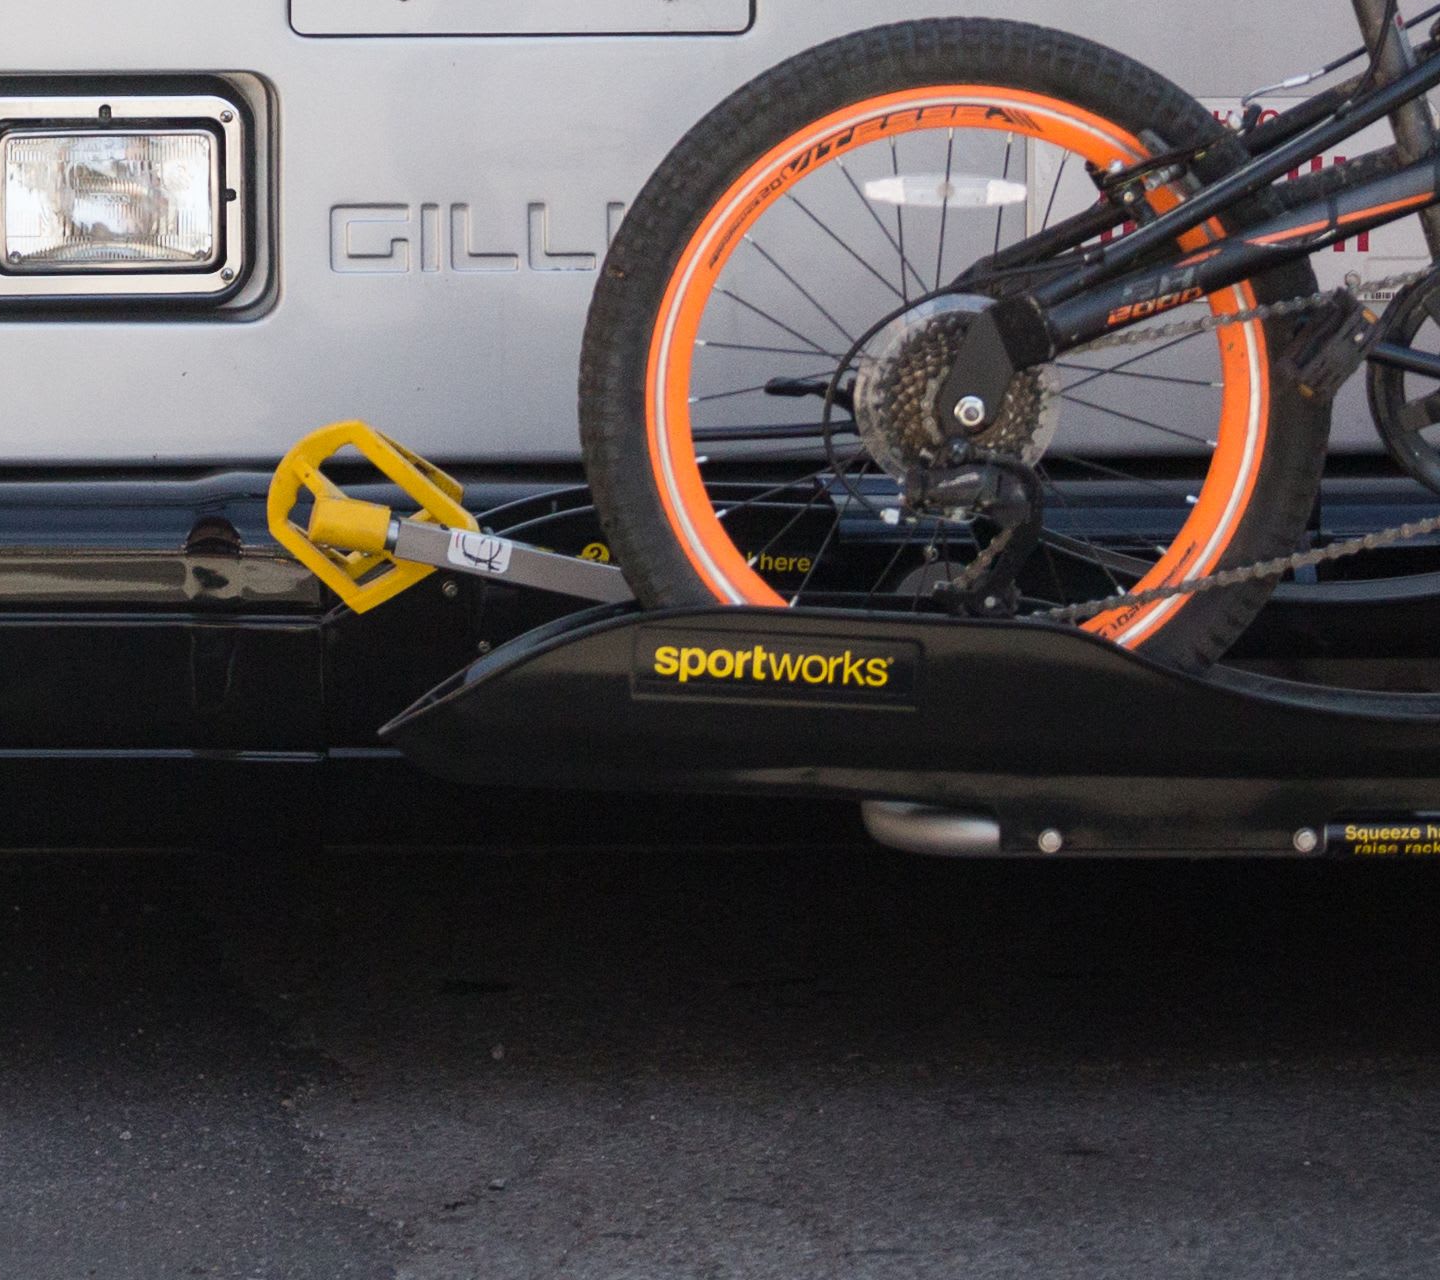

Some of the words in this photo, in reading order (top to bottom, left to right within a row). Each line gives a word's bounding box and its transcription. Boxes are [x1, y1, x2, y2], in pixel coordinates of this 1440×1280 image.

[759, 552, 812, 573] here
[1344, 824, 1422, 842] Squeeze
[1354, 842, 1398, 855] raise
